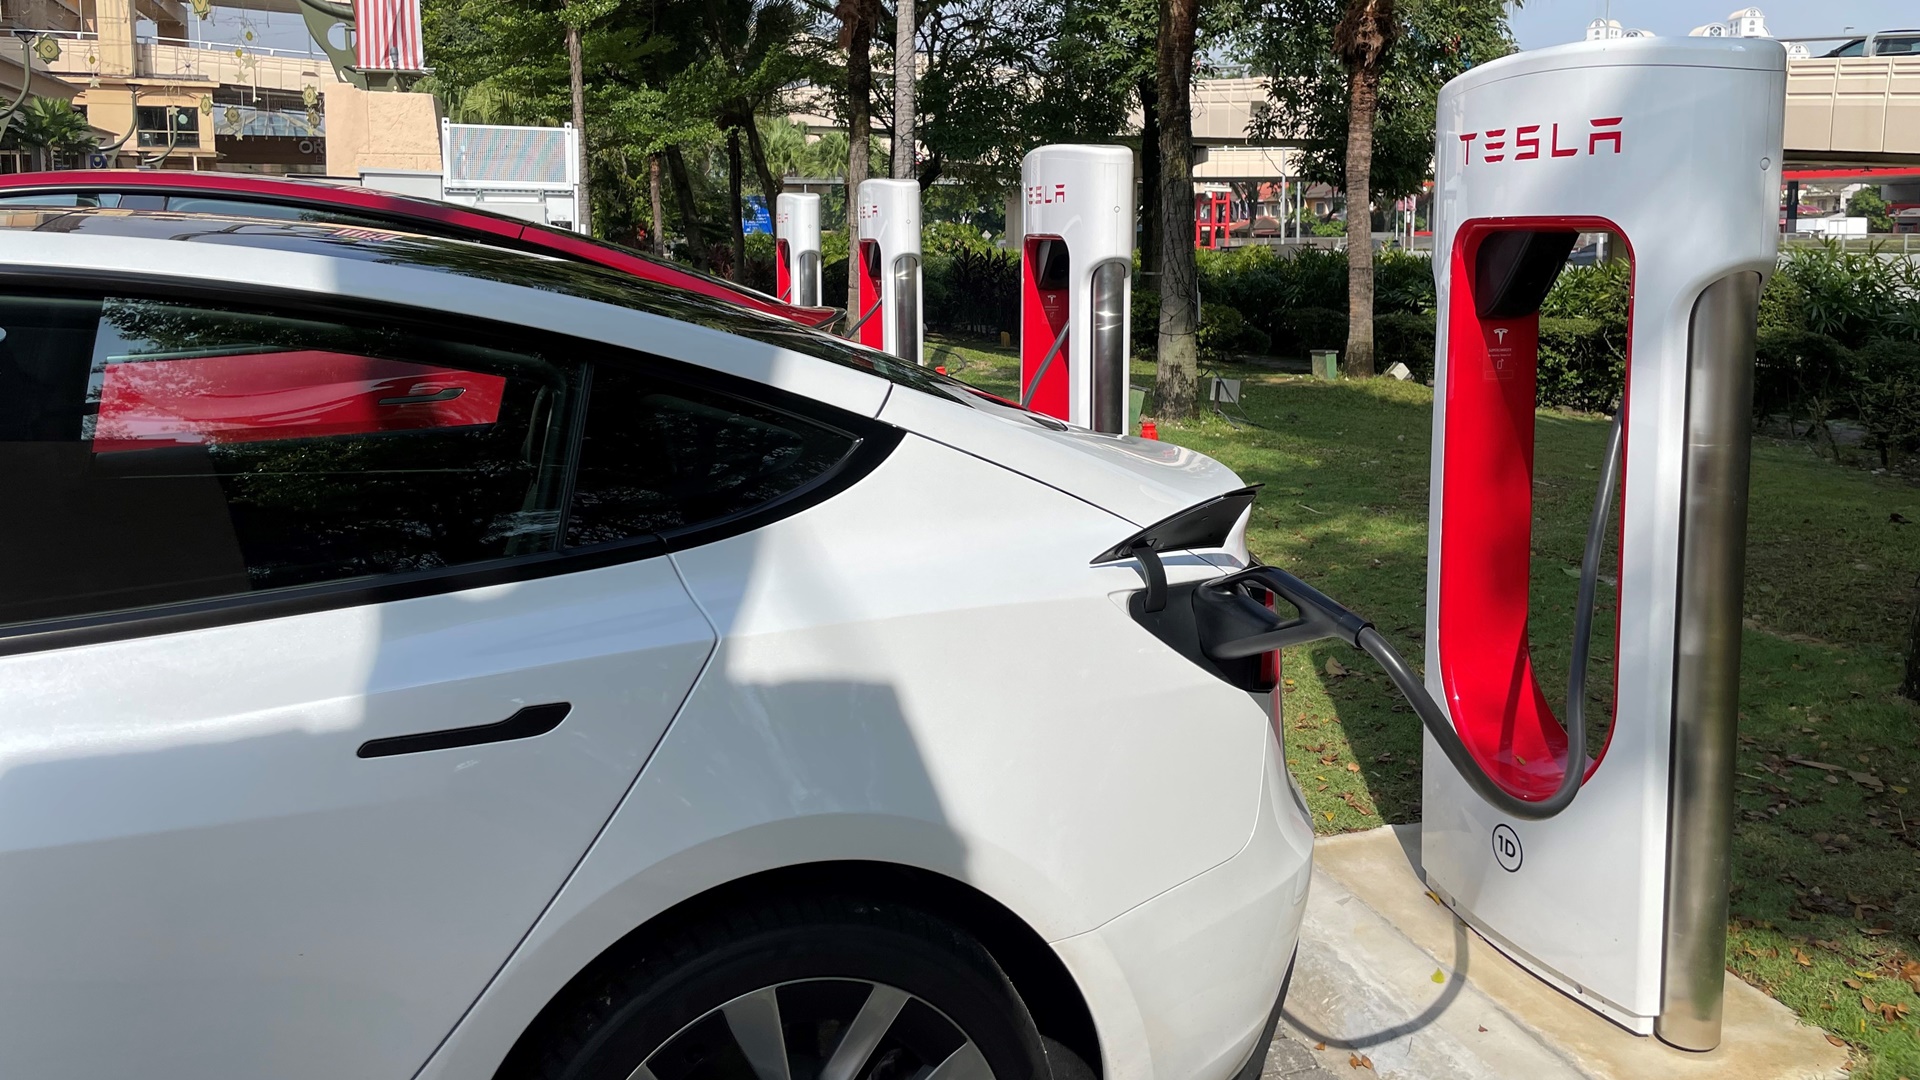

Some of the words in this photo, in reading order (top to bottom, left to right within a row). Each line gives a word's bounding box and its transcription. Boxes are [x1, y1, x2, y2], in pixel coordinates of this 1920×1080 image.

[1459, 117, 1623, 165] TESLA
[1026, 184, 1066, 205] ESLA
[1498, 835, 1516, 858] 1D
